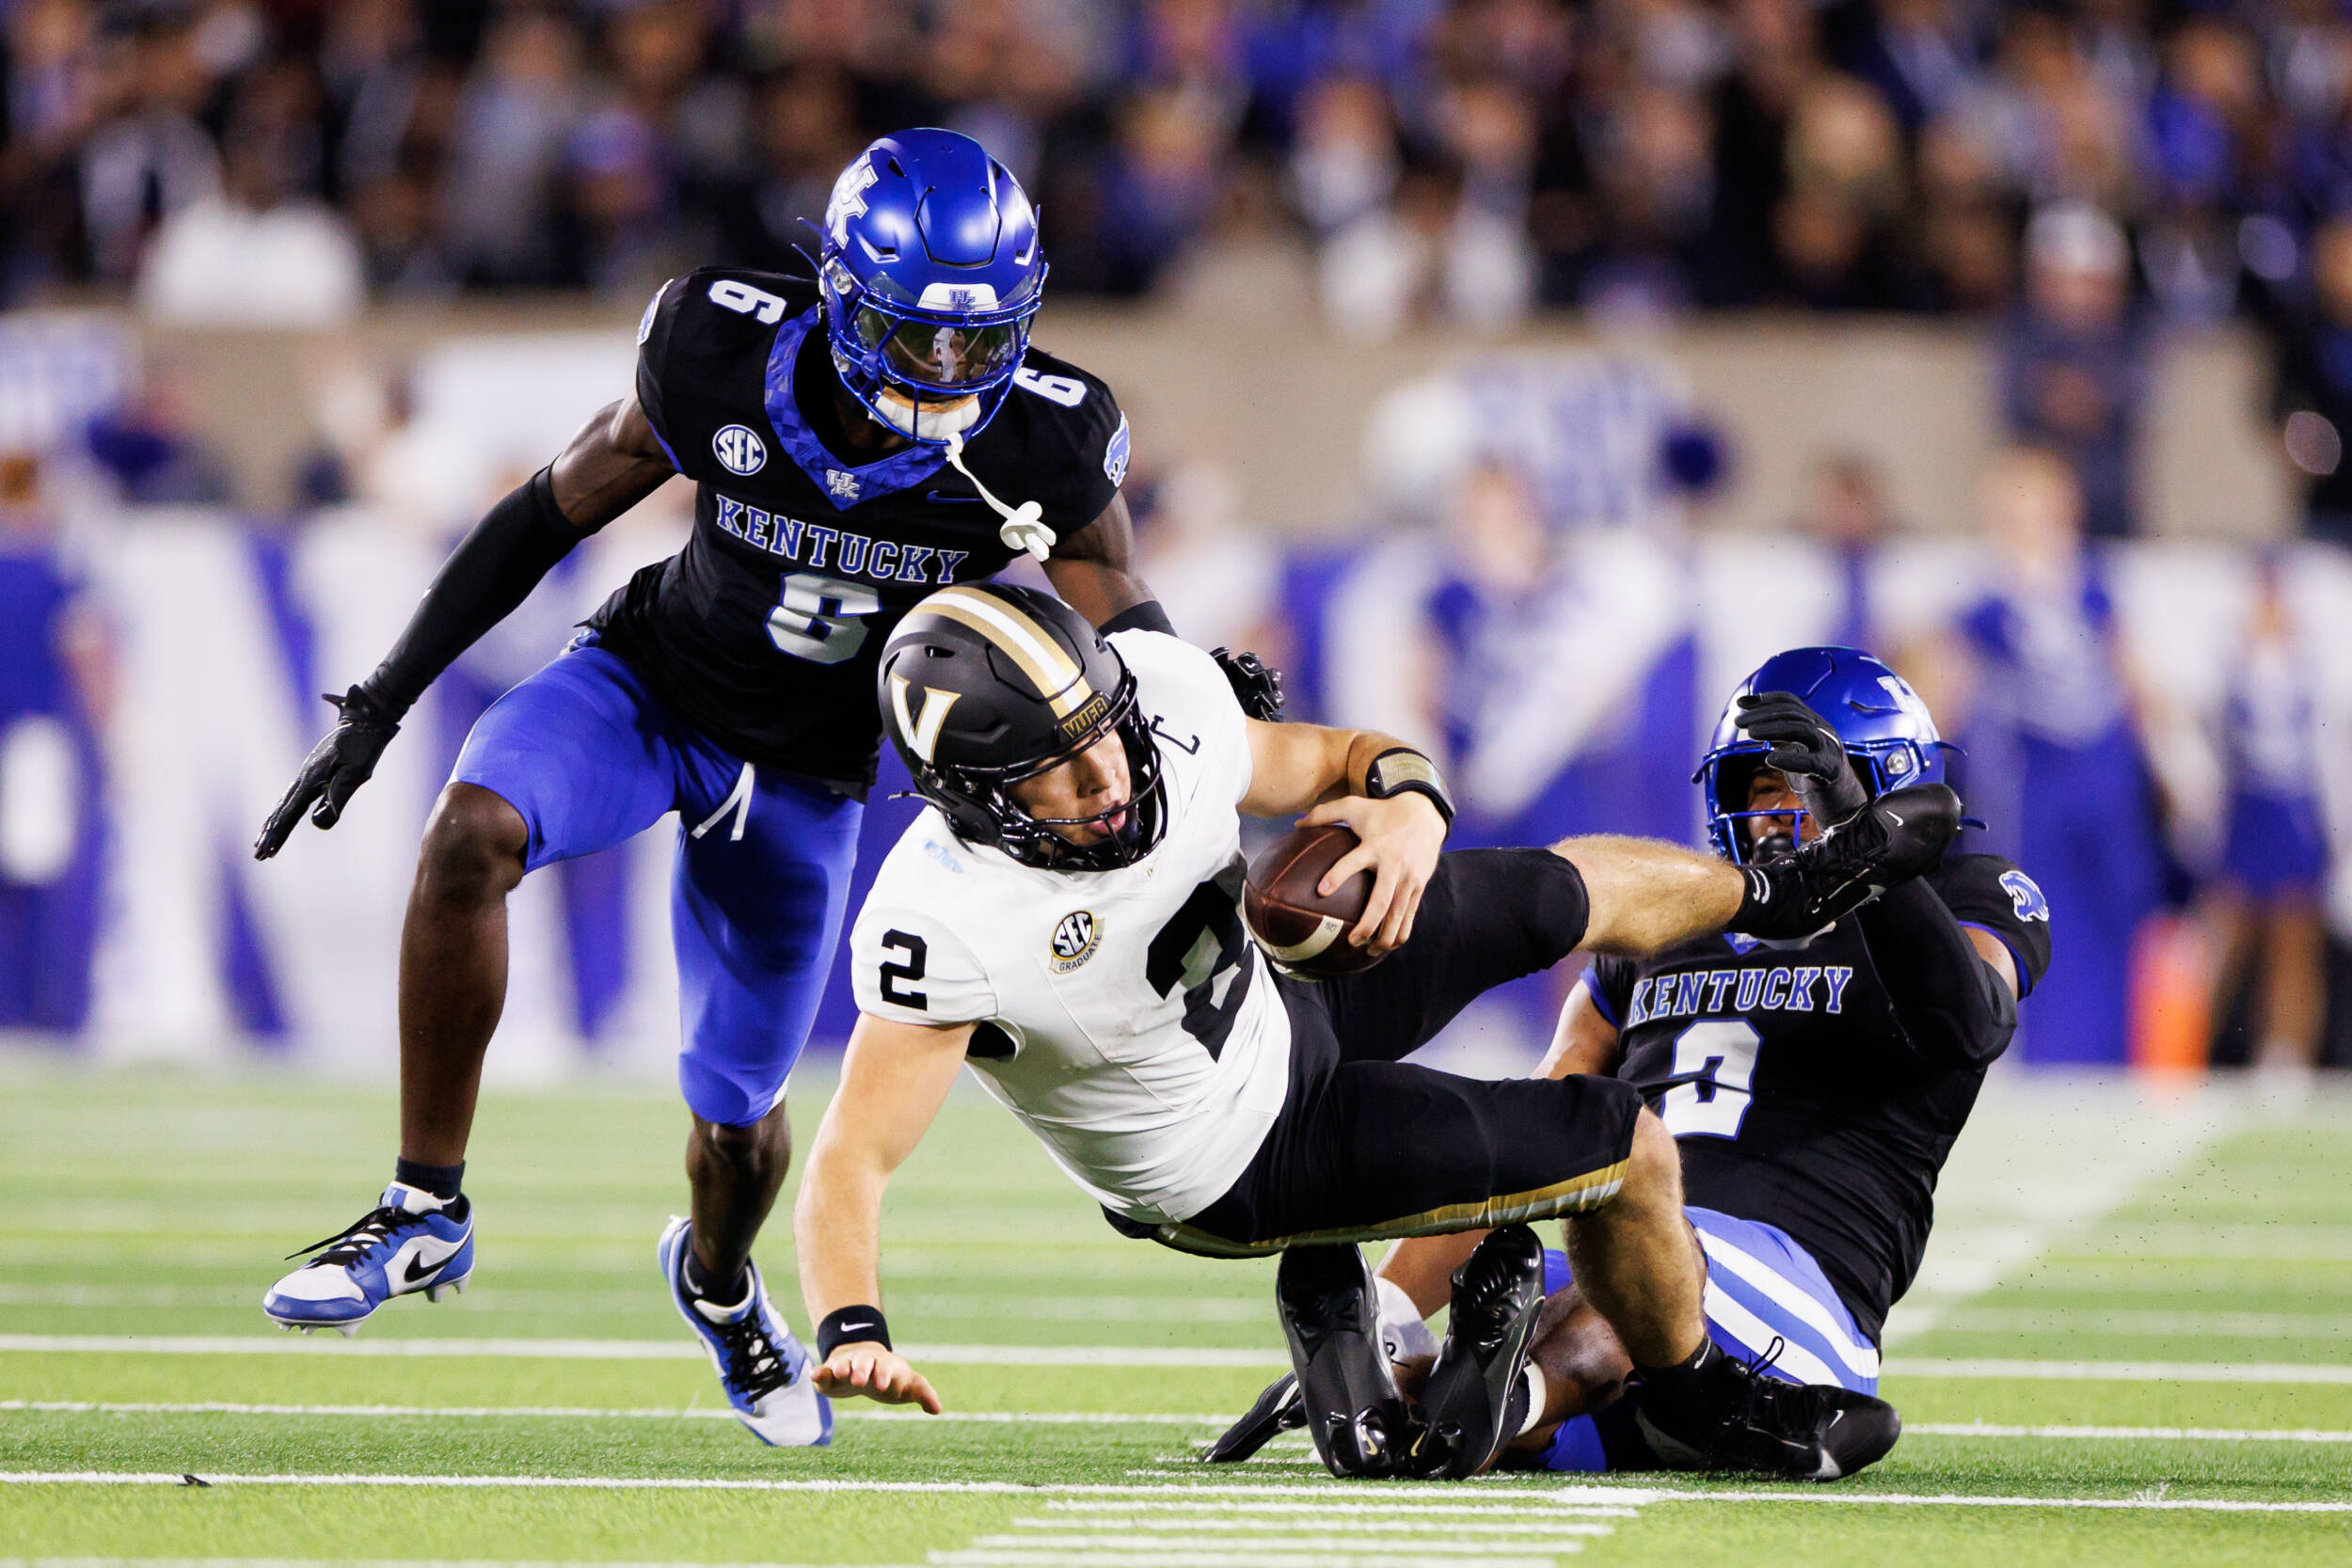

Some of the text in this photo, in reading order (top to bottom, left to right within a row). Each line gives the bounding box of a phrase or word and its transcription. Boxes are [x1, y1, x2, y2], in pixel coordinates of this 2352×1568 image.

[716, 428, 763, 472] SEC
[826, 468, 861, 500] UK
[715, 493, 969, 583] KENTUCKY
[762, 571, 882, 665] 6
[890, 672, 961, 765] V
[1061, 696, 1109, 739] VUFB
[1054, 912, 1093, 957] SEC
[1058, 933, 1103, 972] GRADUATE
[1146, 850, 1255, 1064] 2
[880, 927, 928, 1011] 2
[1627, 966, 1853, 1029] KENTUCKY
